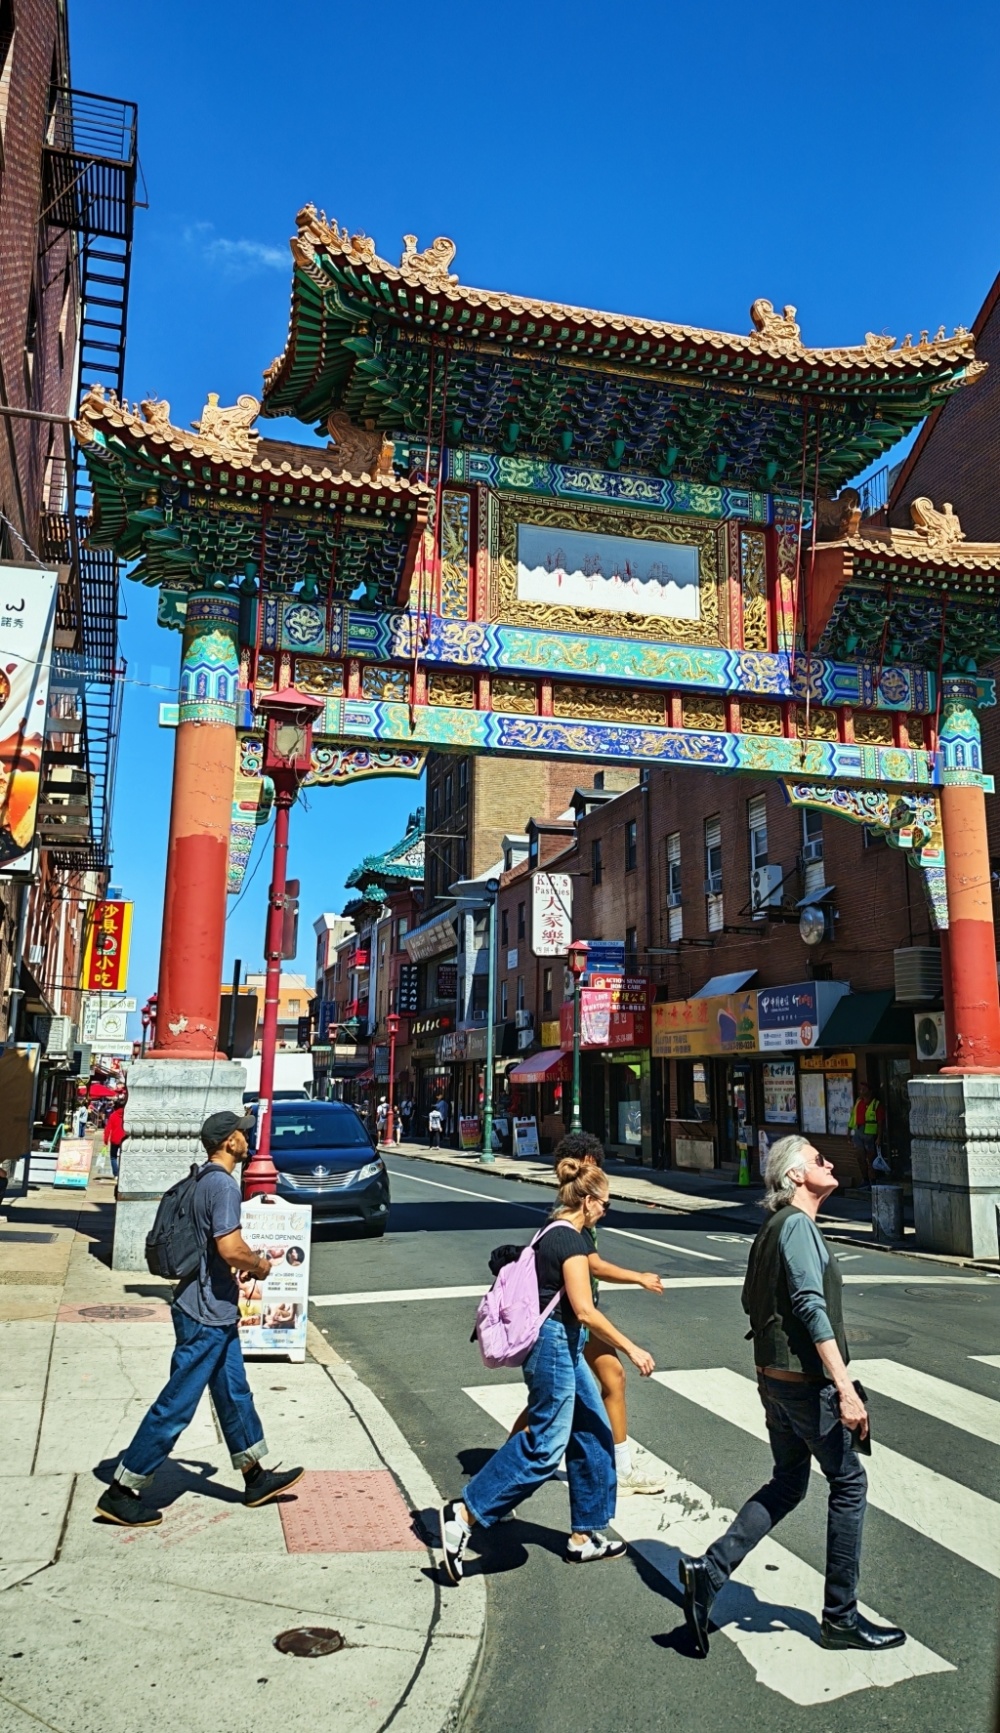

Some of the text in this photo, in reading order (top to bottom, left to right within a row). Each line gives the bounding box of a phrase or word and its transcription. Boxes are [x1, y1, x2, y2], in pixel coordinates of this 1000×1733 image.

[535, 886, 570, 896] Pasties
[541, 896, 564, 945] 大家樂
[409, 966, 418, 1011] PENANG
